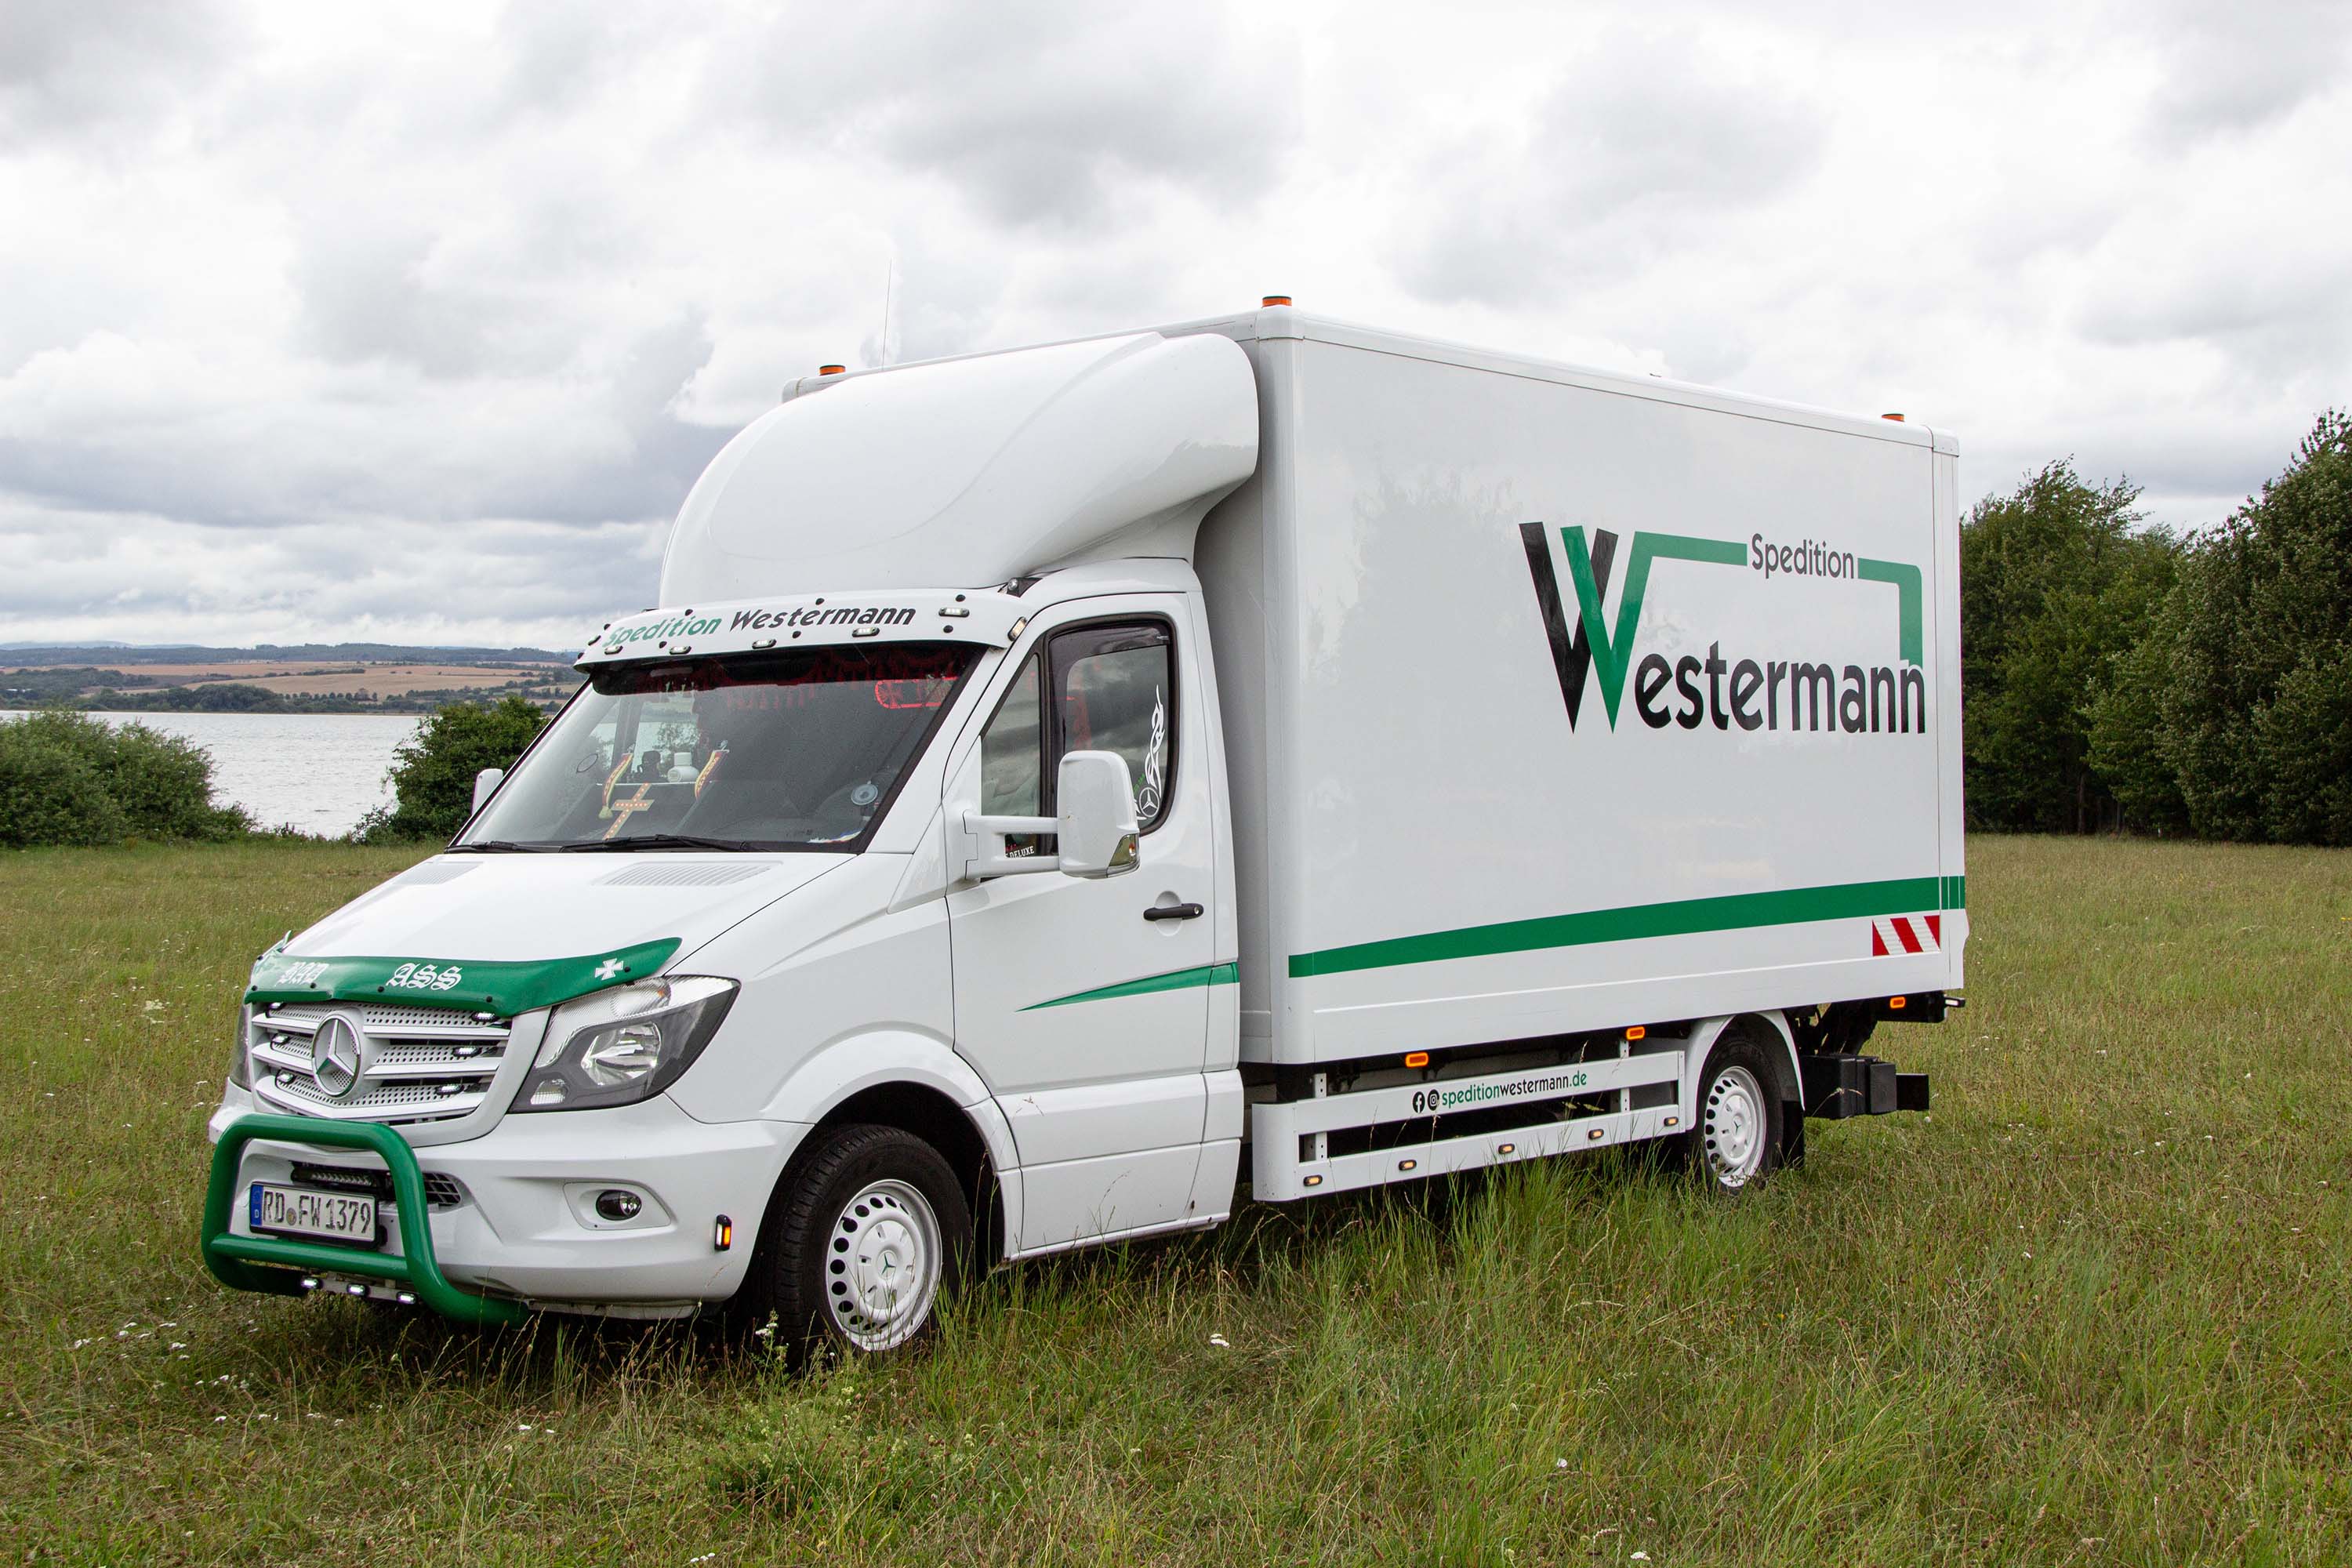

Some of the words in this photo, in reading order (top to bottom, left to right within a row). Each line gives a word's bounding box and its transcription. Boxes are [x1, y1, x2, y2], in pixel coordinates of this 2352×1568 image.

[1751, 533, 1855, 579] Spedition
[602, 615, 722, 648] Spedition
[729, 607, 916, 632] Westermann
[1519, 521, 1926, 735] Westermann
[1009, 845, 1035, 859] DELUXE
[386, 963, 463, 990] ASS
[1442, 1071, 1588, 1109] speditionwestermann.de
[262, 1190, 285, 1224] RD
[299, 1195, 321, 1228] FW
[325, 1198, 372, 1234] 1379
